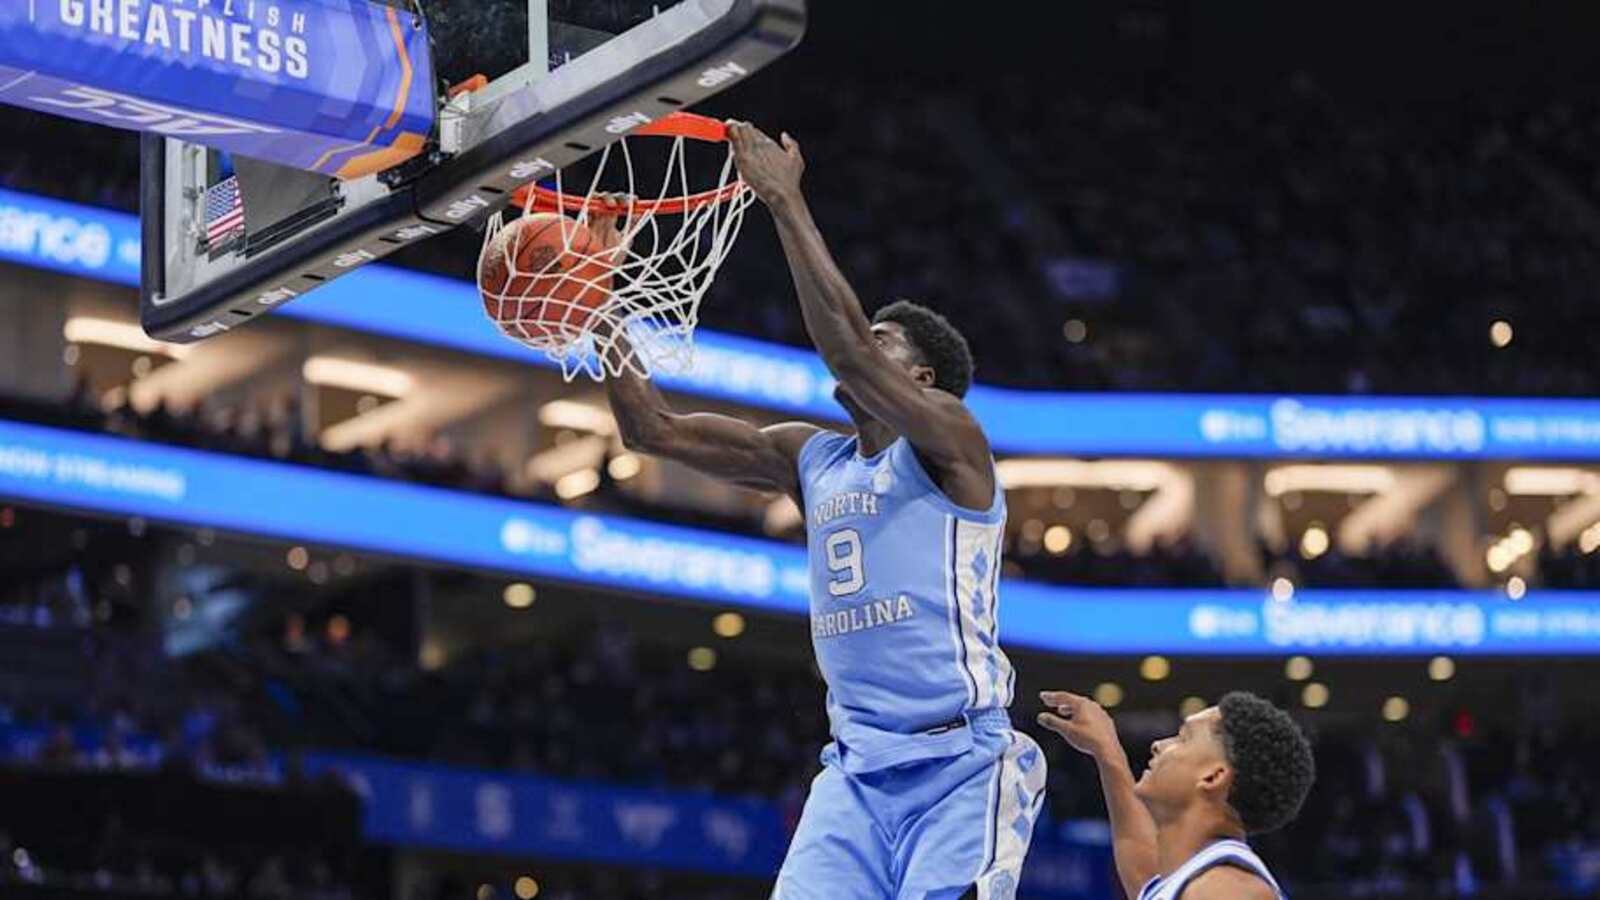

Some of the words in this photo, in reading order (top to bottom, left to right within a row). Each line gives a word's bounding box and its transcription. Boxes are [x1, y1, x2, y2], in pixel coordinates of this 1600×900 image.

[60, 0, 309, 79] GREATNESS
[698, 61, 748, 88] ally
[605, 111, 652, 133] ally
[509, 156, 555, 179] ally
[446, 194, 489, 219] ally
[813, 491, 879, 529] NORTH
[826, 529, 865, 597] 9
